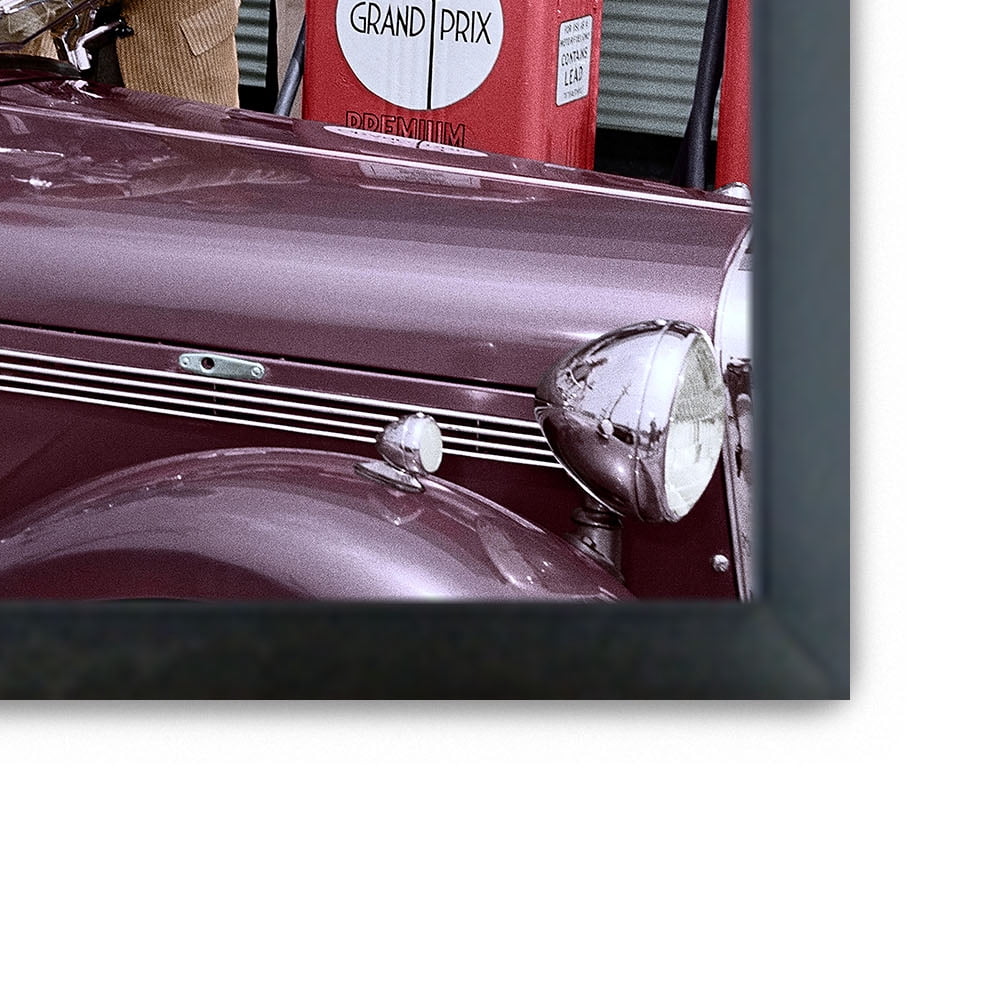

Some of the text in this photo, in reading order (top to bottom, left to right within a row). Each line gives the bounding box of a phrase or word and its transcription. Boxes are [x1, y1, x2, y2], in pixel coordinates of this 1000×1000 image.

[350, 1, 492, 45] GRAND PRIX
[564, 66, 584, 87] LEAD
